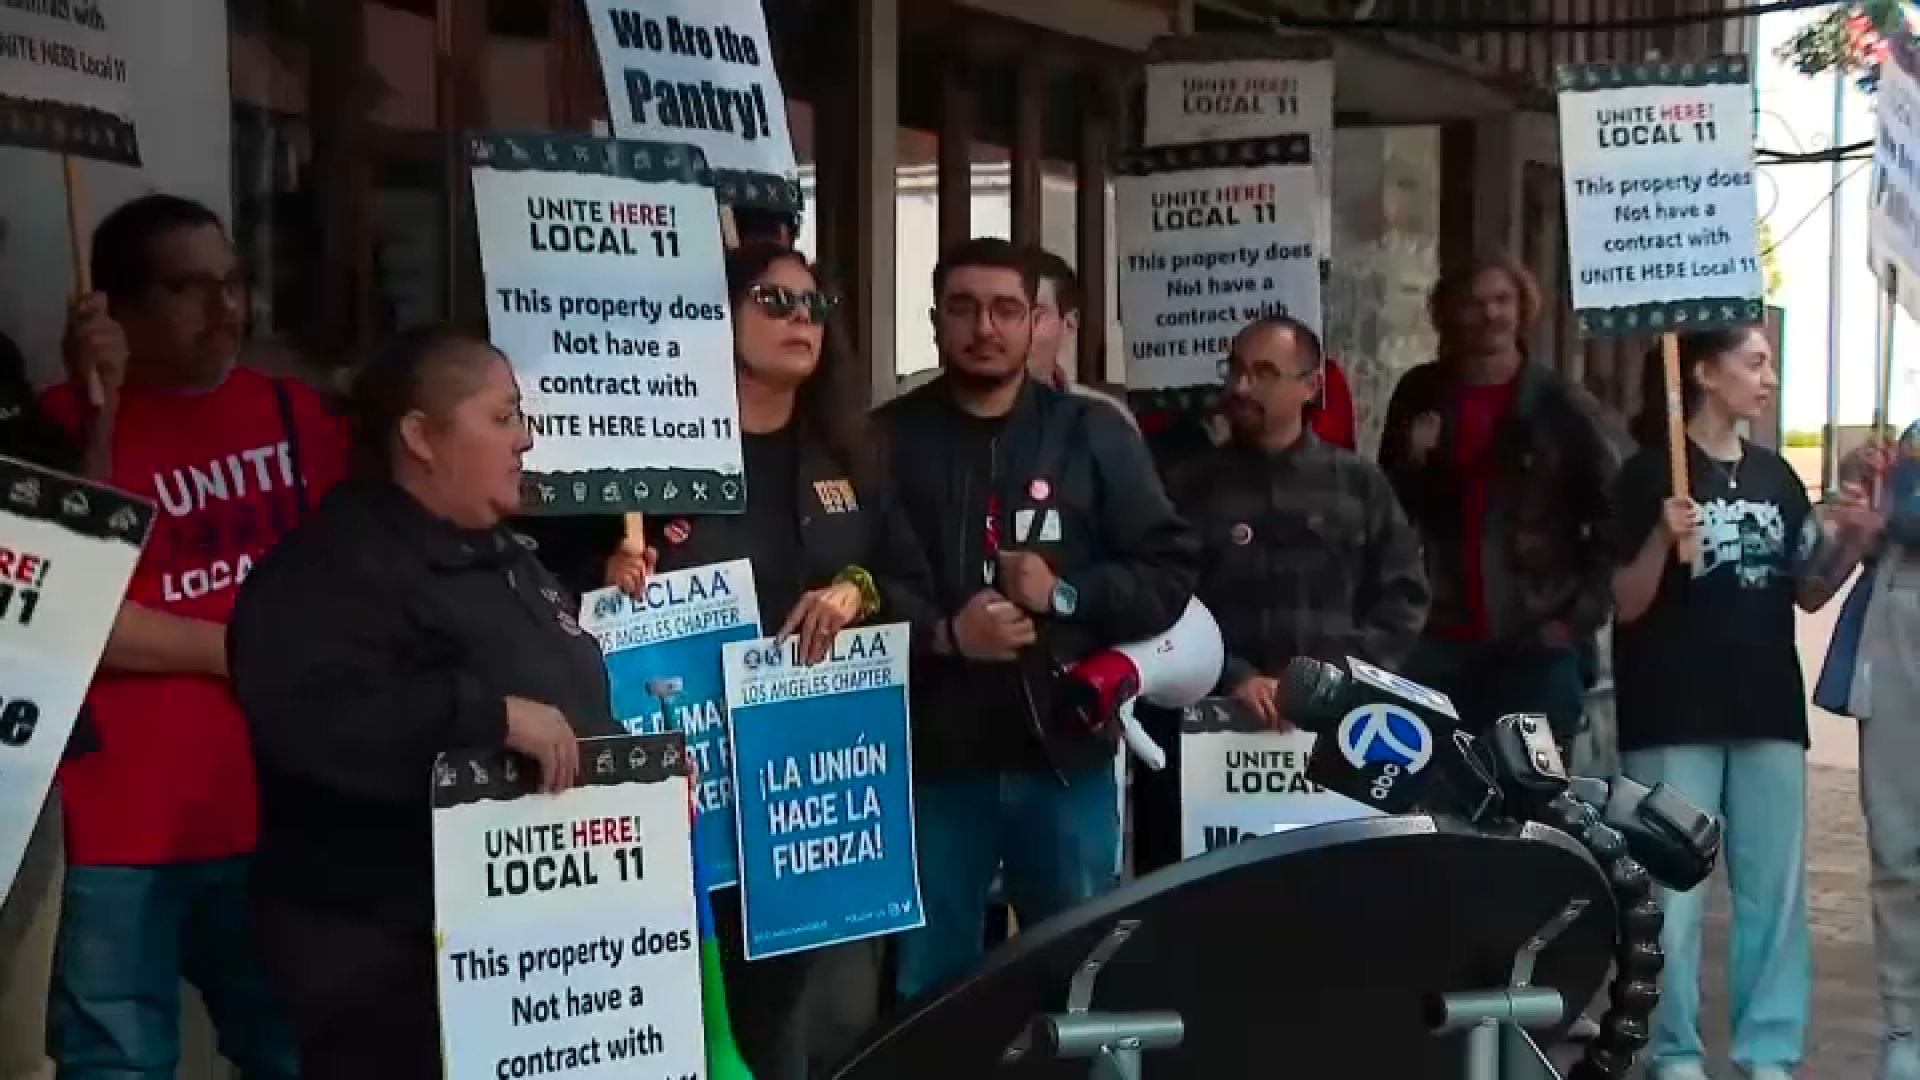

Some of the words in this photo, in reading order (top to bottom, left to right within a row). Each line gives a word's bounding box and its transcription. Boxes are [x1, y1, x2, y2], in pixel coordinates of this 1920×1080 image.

[609, 9, 662, 52] We
[666, 16, 713, 60] Are
[715, 24, 760, 66] the
[624, 68, 770, 141] Pantry!
[1596, 105, 1655, 126] UNITE
[1659, 102, 1714, 122] HERE!
[1598, 123, 1683, 149] LOCAL
[1693, 121, 1716, 144] 11
[1574, 175, 1616, 196] This
[1620, 173, 1702, 198] property
[1706, 168, 1751, 189] does
[528, 196, 603, 222] UNITE
[610, 201, 677, 228] HERE!
[1152, 204, 1241, 232] LOCAL
[1253, 203, 1276, 224] 11
[1615, 205, 1651, 223] Not
[1656, 201, 1700, 221] have
[1704, 203, 1717, 218] a
[530, 222, 638, 256] LOCAL
[650, 229, 681, 258] 11
[1604, 231, 1684, 253] contract
[1688, 226, 1731, 248] with
[1128, 252, 1167, 273] This
[1171, 246, 1260, 274] property
[1264, 241, 1313, 261] does
[1581, 265, 1636, 285] UNITE
[1642, 261, 1687, 281] HERE
[1691, 257, 1736, 278] Local
[1738, 257, 1757, 275] 11
[1166, 279, 1203, 298] Not
[1208, 276, 1257, 295] have
[1263, 276, 1275, 290] a
[497, 288, 552, 315] This
[558, 293, 663, 325] property
[668, 295, 727, 322] does
[1155, 304, 1238, 328] contract
[553, 329, 599, 356] Not
[605, 329, 660, 358] have
[666, 340, 681, 359] a
[1132, 339, 1188, 361] UNITE
[539, 372, 642, 397] contract
[647, 373, 700, 399] with
[526, 414, 582, 438] NITE
[588, 415, 647, 438] HERE
[651, 416, 706, 440] Local
[710, 417, 733, 440] 11
[161, 554, 253, 604] LOCA
[674, 606, 740, 637] CHAPTER
[791, 632, 887, 668] LLAA
[742, 683, 766, 705] LOS
[771, 673, 829, 700] ANGELES
[832, 667, 892, 692] CHAPTER
[809, 731, 888, 788] UNIÓN
[1226, 750, 1295, 769] UNITE
[1370, 763, 1401, 801] abc
[767, 792, 840, 836] HACE
[847, 785, 881, 823] LA
[485, 823, 565, 859] UNITE
[571, 815, 641, 850] HERE!
[772, 822, 885, 881] FUERZA!
[486, 850, 599, 897] LOCAL
[613, 847, 645, 882] 11
[450, 946, 510, 983] This
[518, 934, 625, 983] property
[631, 926, 692, 957] does
[511, 993, 561, 1027] Not
[567, 985, 623, 1018] have
[629, 985, 645, 1008] a
[495, 1035, 601, 1080] contract
[607, 1023, 664, 1060] with
